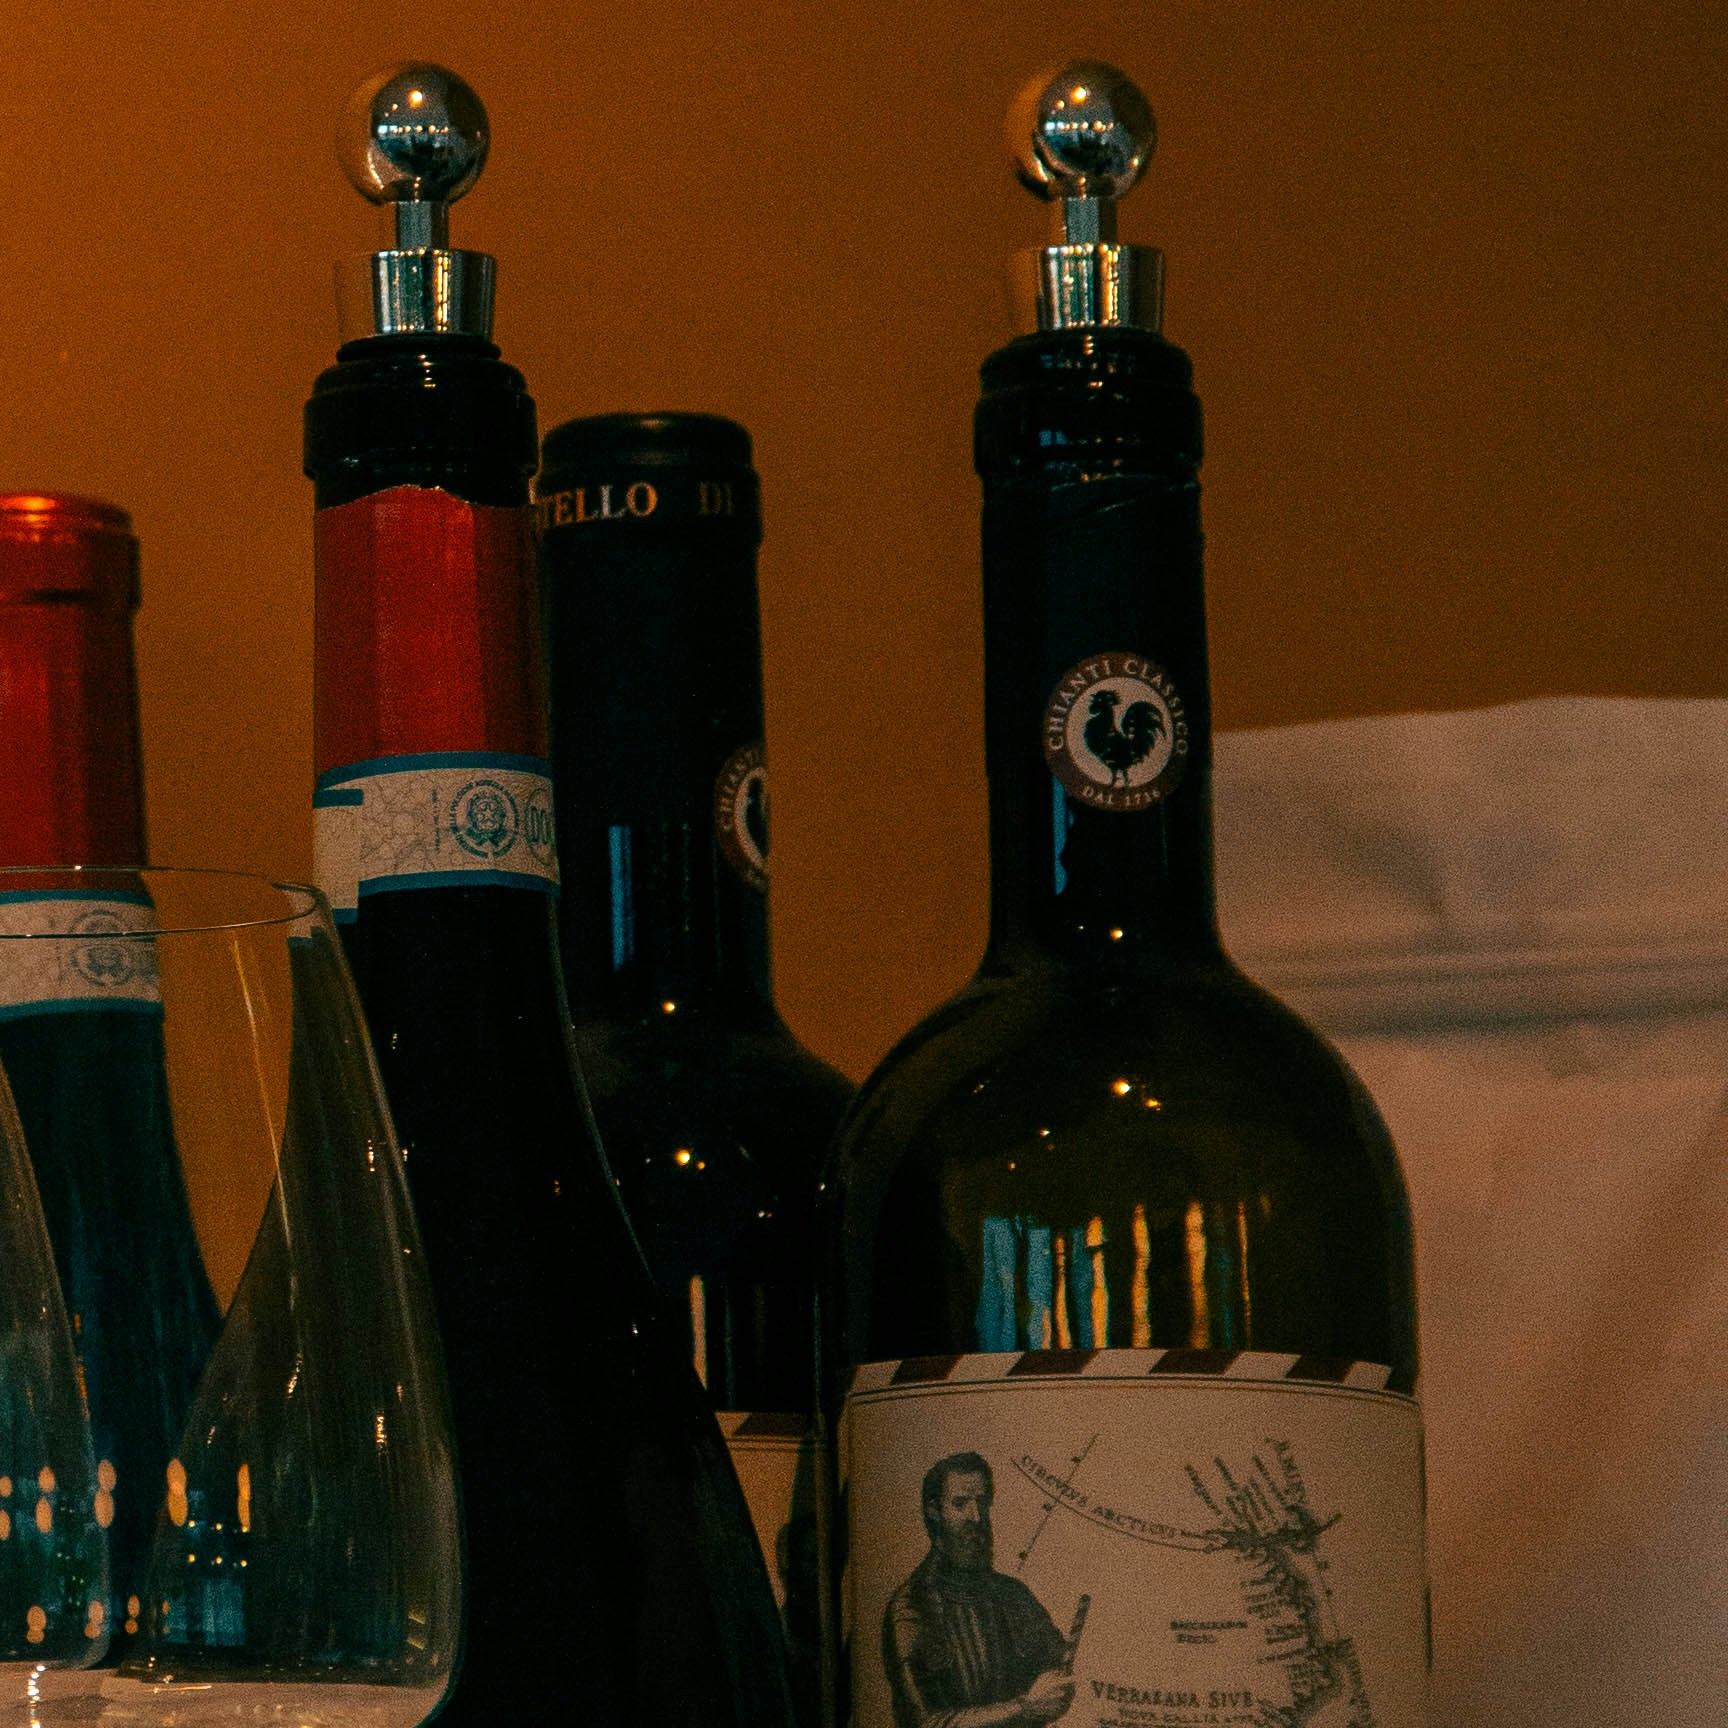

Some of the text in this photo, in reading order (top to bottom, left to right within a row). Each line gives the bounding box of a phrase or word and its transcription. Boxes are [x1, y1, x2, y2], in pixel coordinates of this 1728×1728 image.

[1047, 657, 1189, 756] CHIANTI CLASSICO
[1081, 785, 1115, 806] DAL
